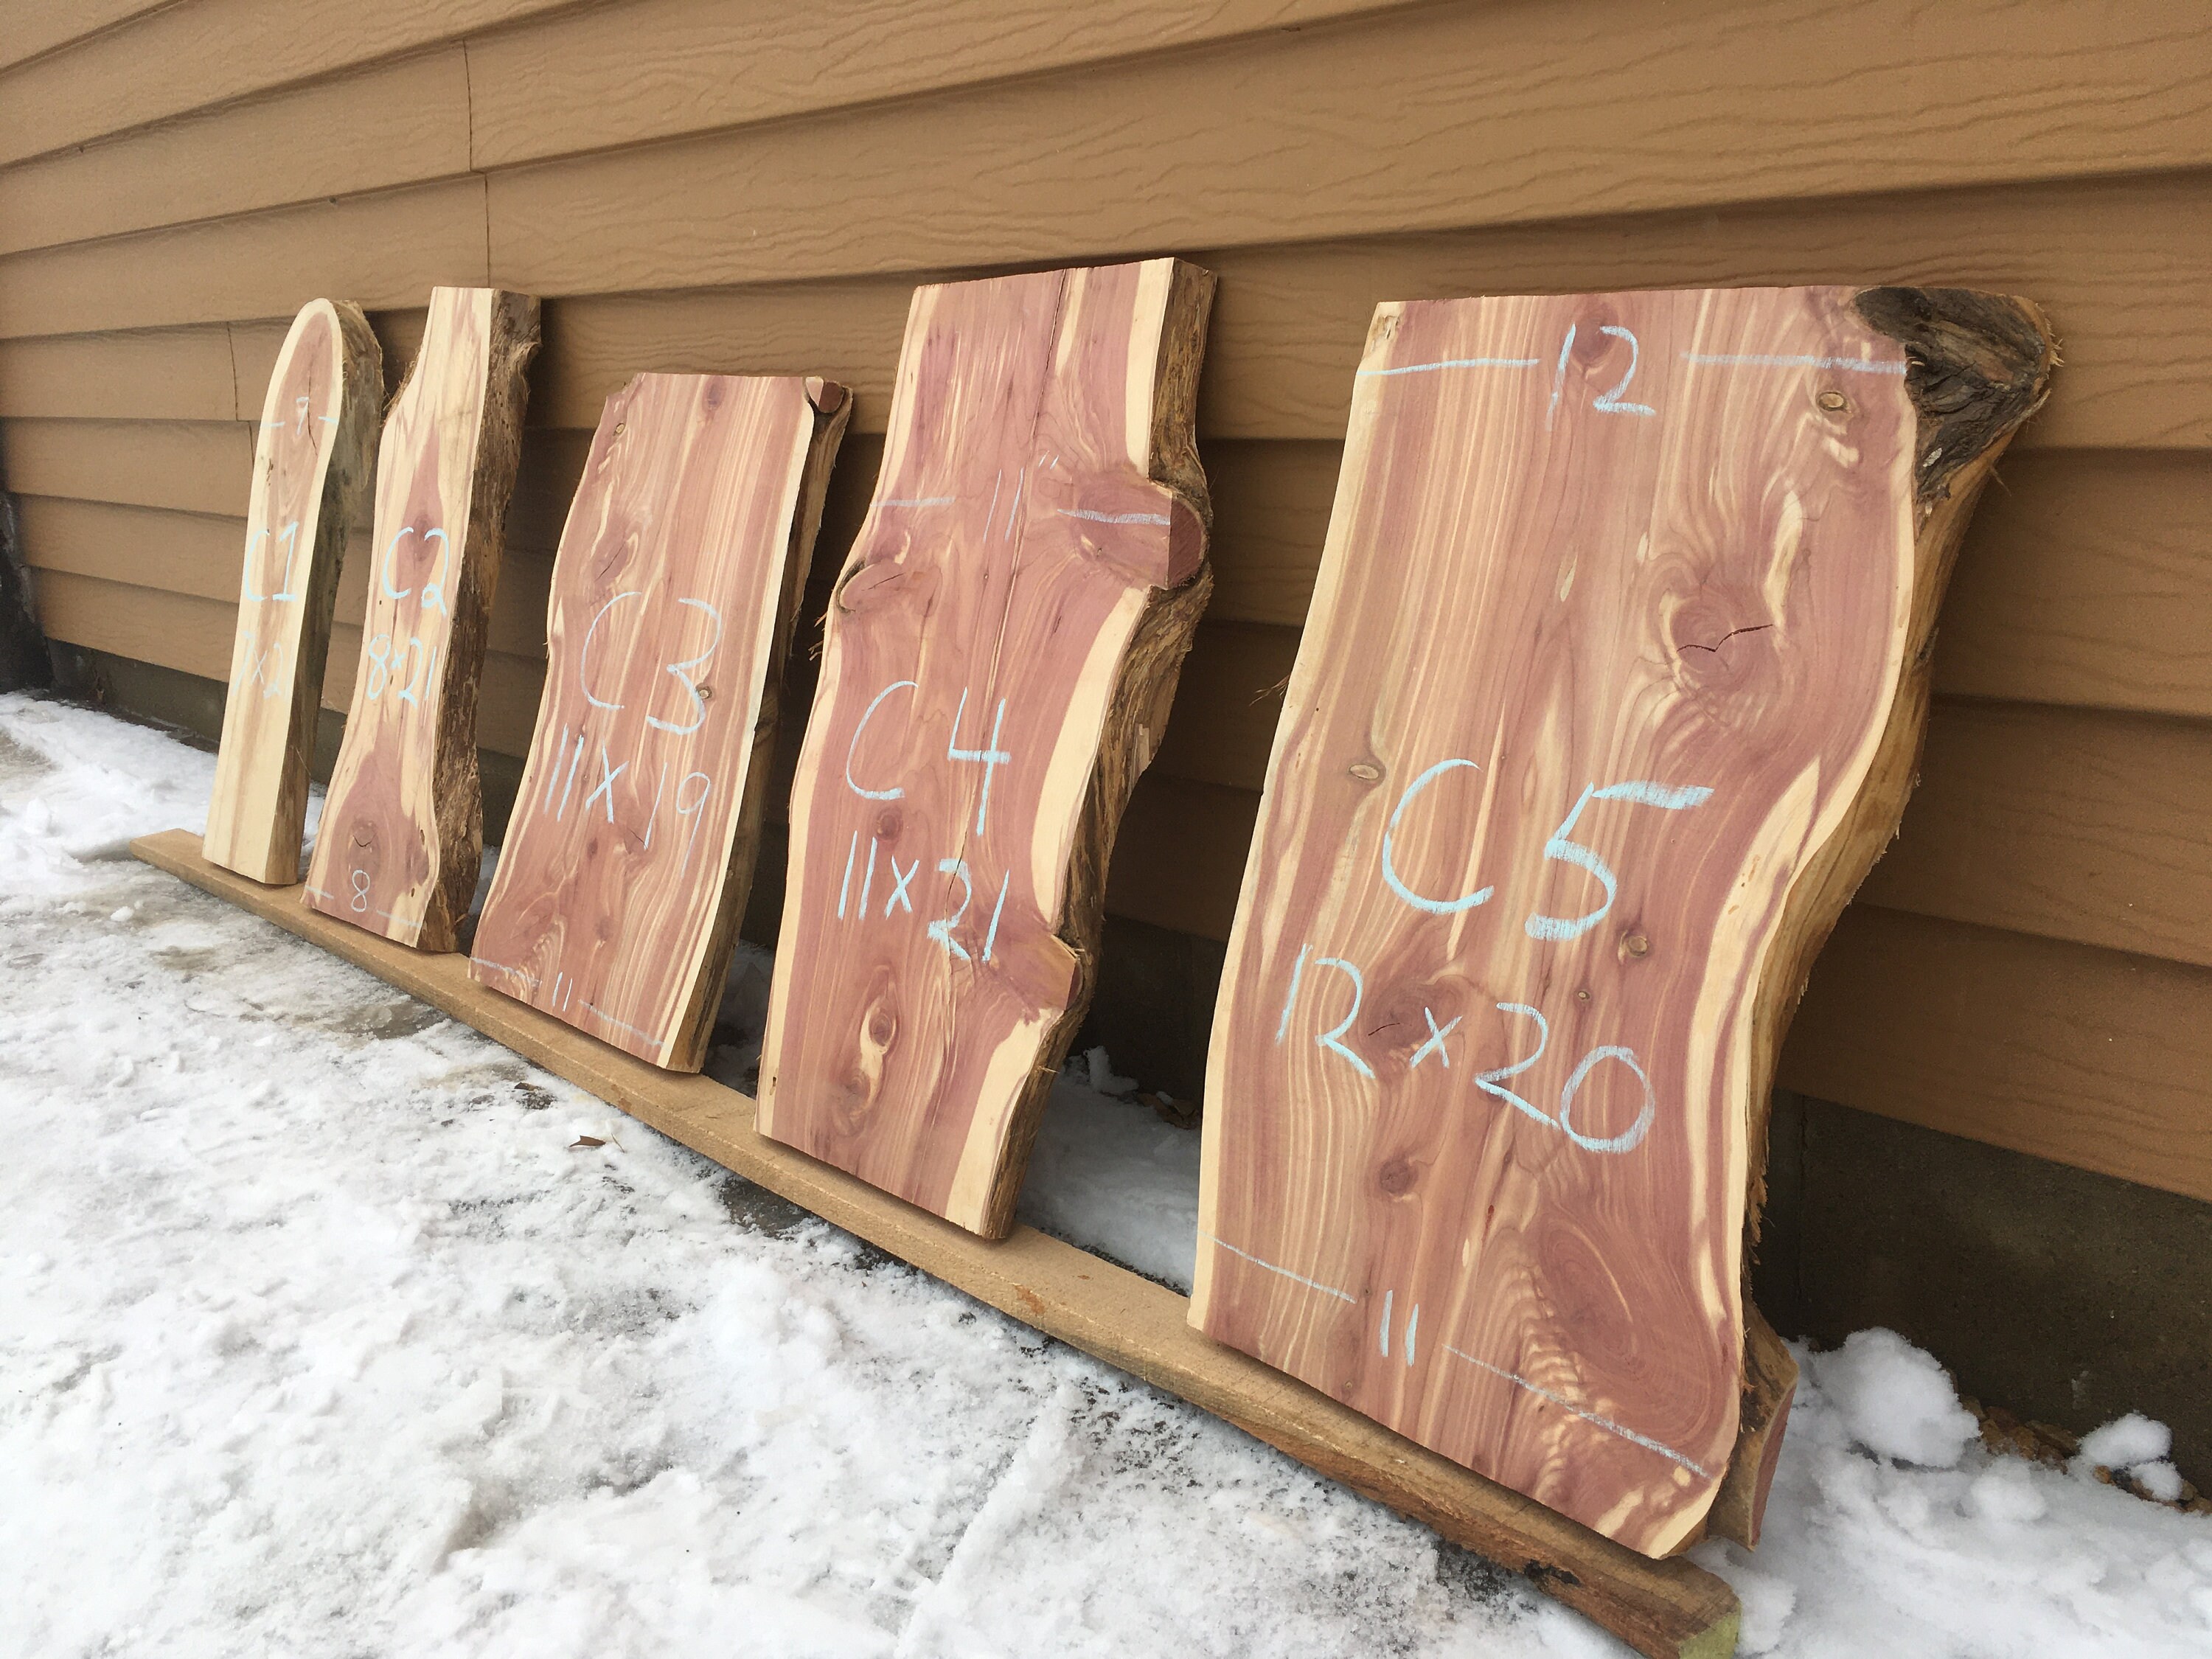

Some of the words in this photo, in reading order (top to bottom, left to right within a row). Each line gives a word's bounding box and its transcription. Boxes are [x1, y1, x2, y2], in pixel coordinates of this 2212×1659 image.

[1545, 323, 1656, 429] 12
[244, 522, 299, 603] C1
[381, 526, 451, 616] C2
[349, 870, 371, 913] 8
[1379, 1290, 1419, 1367] 11
